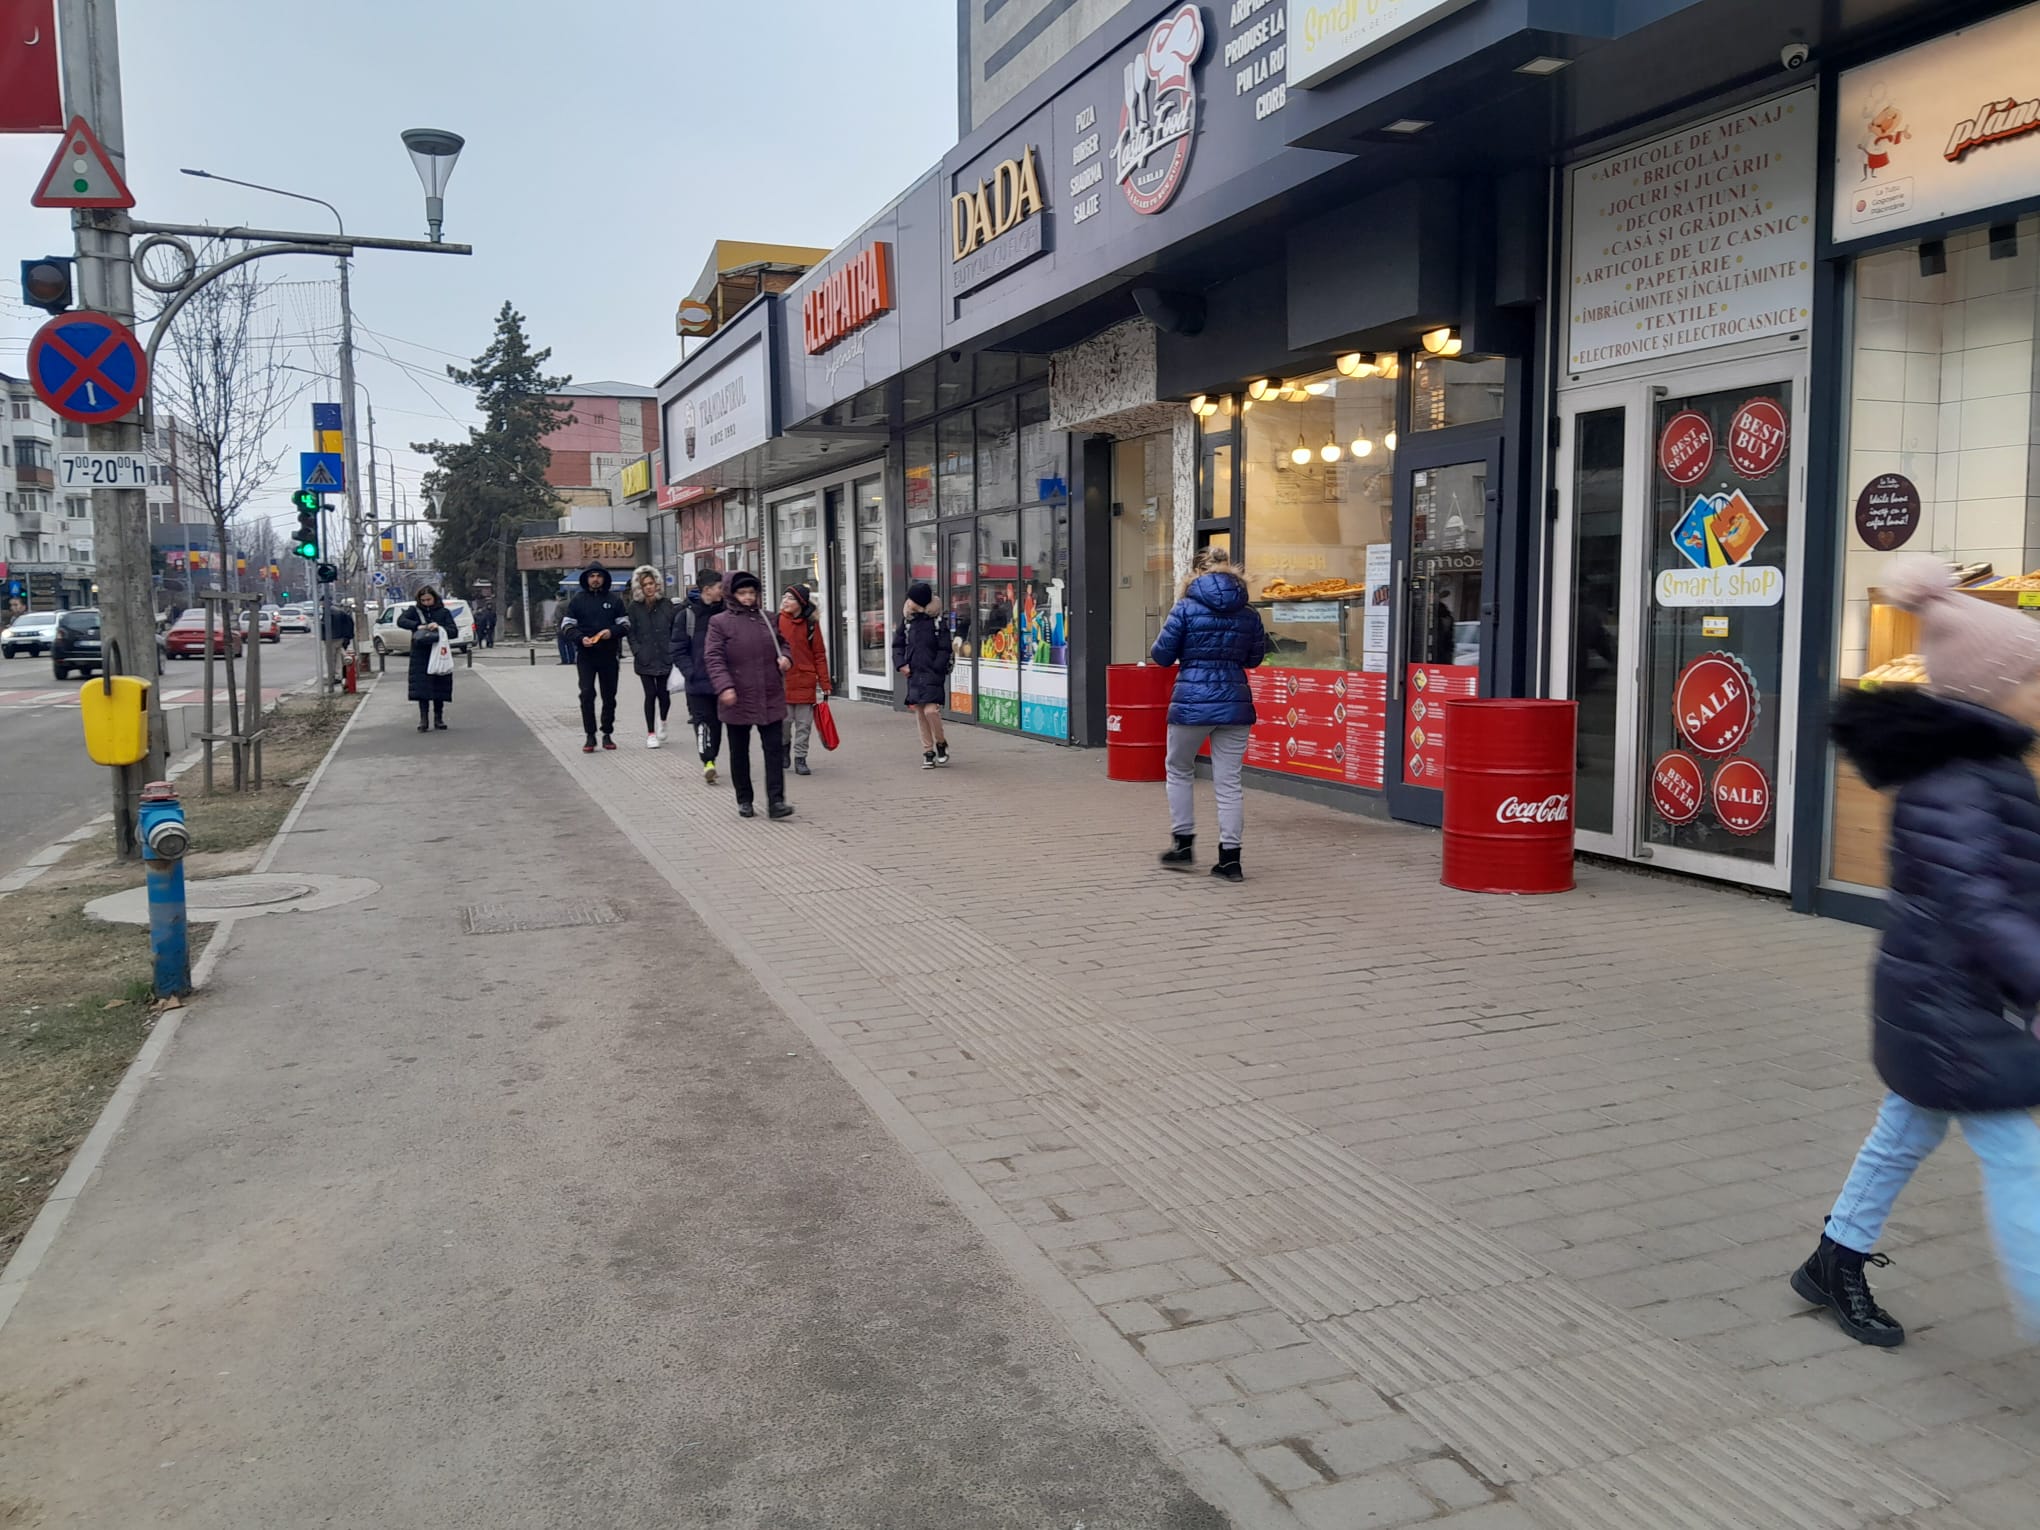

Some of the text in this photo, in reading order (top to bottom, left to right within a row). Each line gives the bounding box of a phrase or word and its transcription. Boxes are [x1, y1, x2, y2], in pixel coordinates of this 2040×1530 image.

[1225, 8, 1286, 68] PRODUSE LA
[1236, 44, 1287, 96] PUI LA RO
[1153, 97, 1192, 146] Food
[1600, 106, 1782, 180] ARTICOLE DE MENAJ
[1609, 188, 1667, 216] JOCURI
[1695, 153, 1769, 189] JUCĂRII
[1644, 145, 1729, 185] BRICOLAJ
[951, 143, 1044, 264] DADA
[1612, 231, 1651, 255] CASĂ
[1680, 199, 1762, 237] GRĂDINĂ
[1584, 216, 1798, 285] ARTICOLE DE UZ CASNIC
[1636, 256, 1731, 291] PAPETĂRIE
[803, 242, 884, 355] CLEOPATRA
[1645, 303, 1718, 330] TEXTILE
[1579, 337, 1658, 364] ELECTRONICE
[1678, 308, 1797, 344] ELECTROCASNICE
[1671, 428, 1698, 455] BEST
[1736, 432, 1773, 461] BUY
[1739, 412, 1784, 446] BEST
[1668, 432, 1710, 472] SELLER
[1663, 570, 1722, 598] Smart
[1686, 677, 1741, 734] SALE
[1656, 771, 1695, 810] SELLER
[1667, 768, 1694, 793] BEST
[1718, 785, 1764, 805] SALE
[1496, 793, 1570, 823] Coca-Cola
